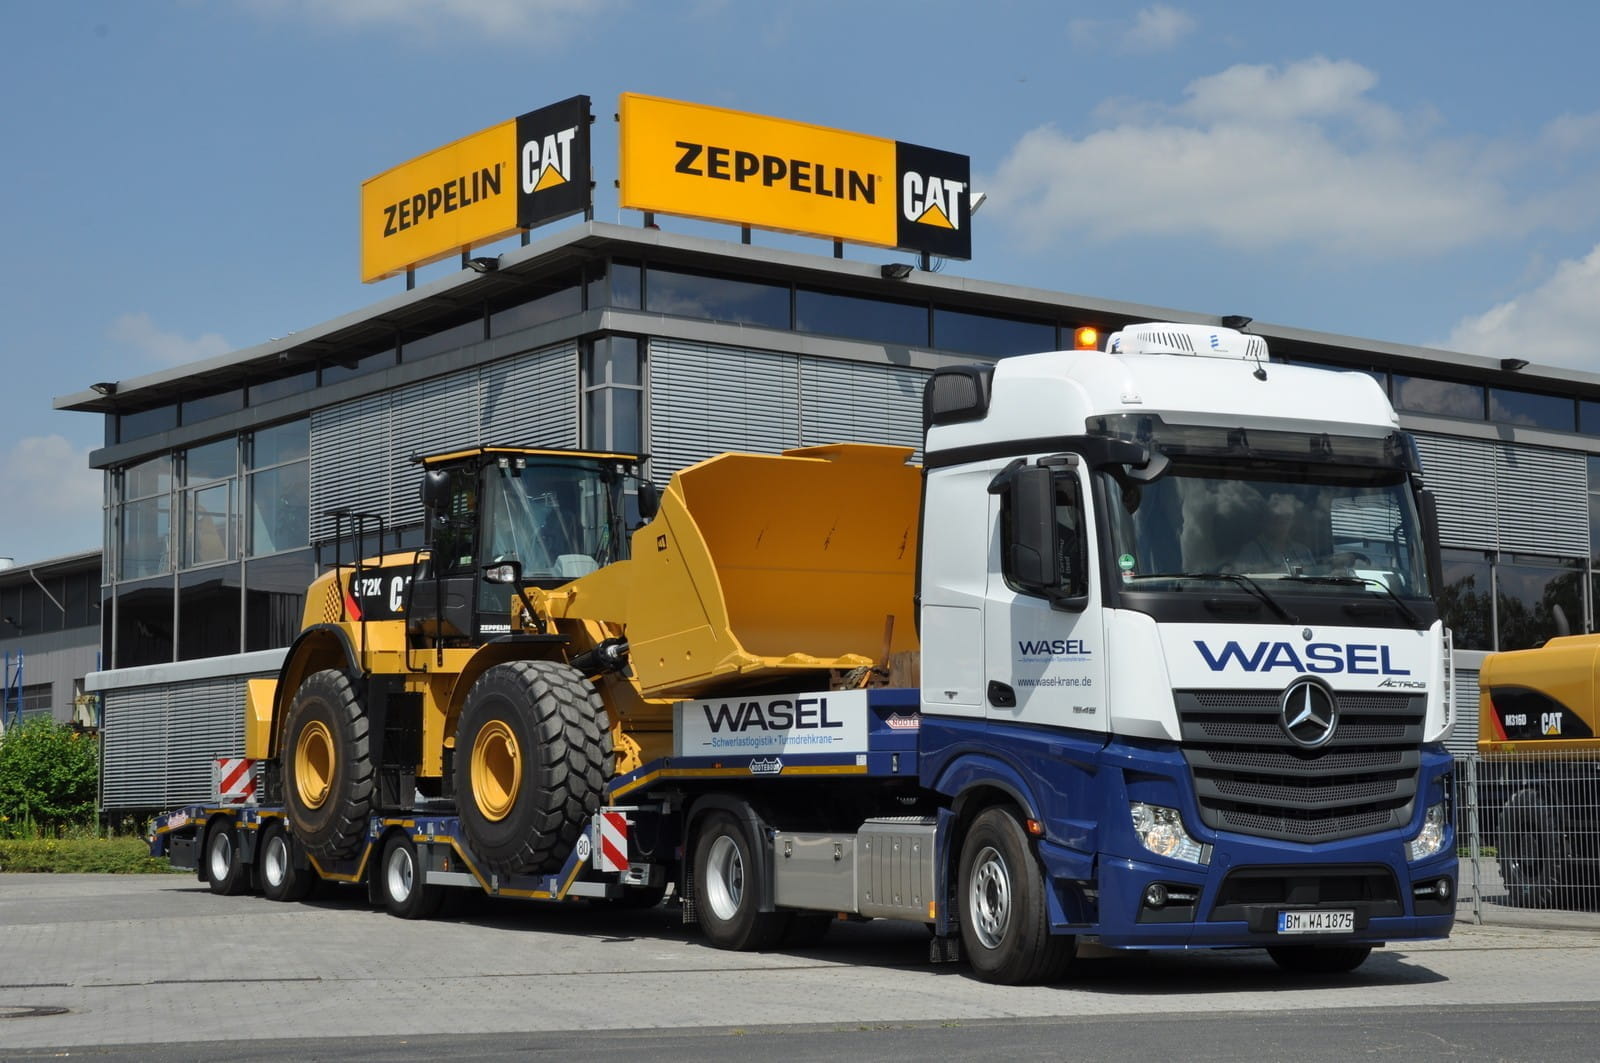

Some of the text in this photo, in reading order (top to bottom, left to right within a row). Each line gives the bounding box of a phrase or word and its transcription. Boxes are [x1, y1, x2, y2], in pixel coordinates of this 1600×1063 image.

[383, 126, 576, 238] ZEPPELIN CAT
[675, 141, 964, 231] ZEPPELIN CAT
[1018, 639, 1093, 656] WASEL
[1193, 640, 1411, 676] WASEL
[1017, 676, 1092, 687] www.wasel-krane.de
[703, 698, 844, 733] WASEL
[892, 718, 919, 726] NOOTE
[1541, 712, 1563, 736] CAT
[712, 734, 833, 750] Schwerlastlogistik Turmdrehkrane
[579, 840, 589, 856] 80
[1286, 914, 1300, 929] BM
